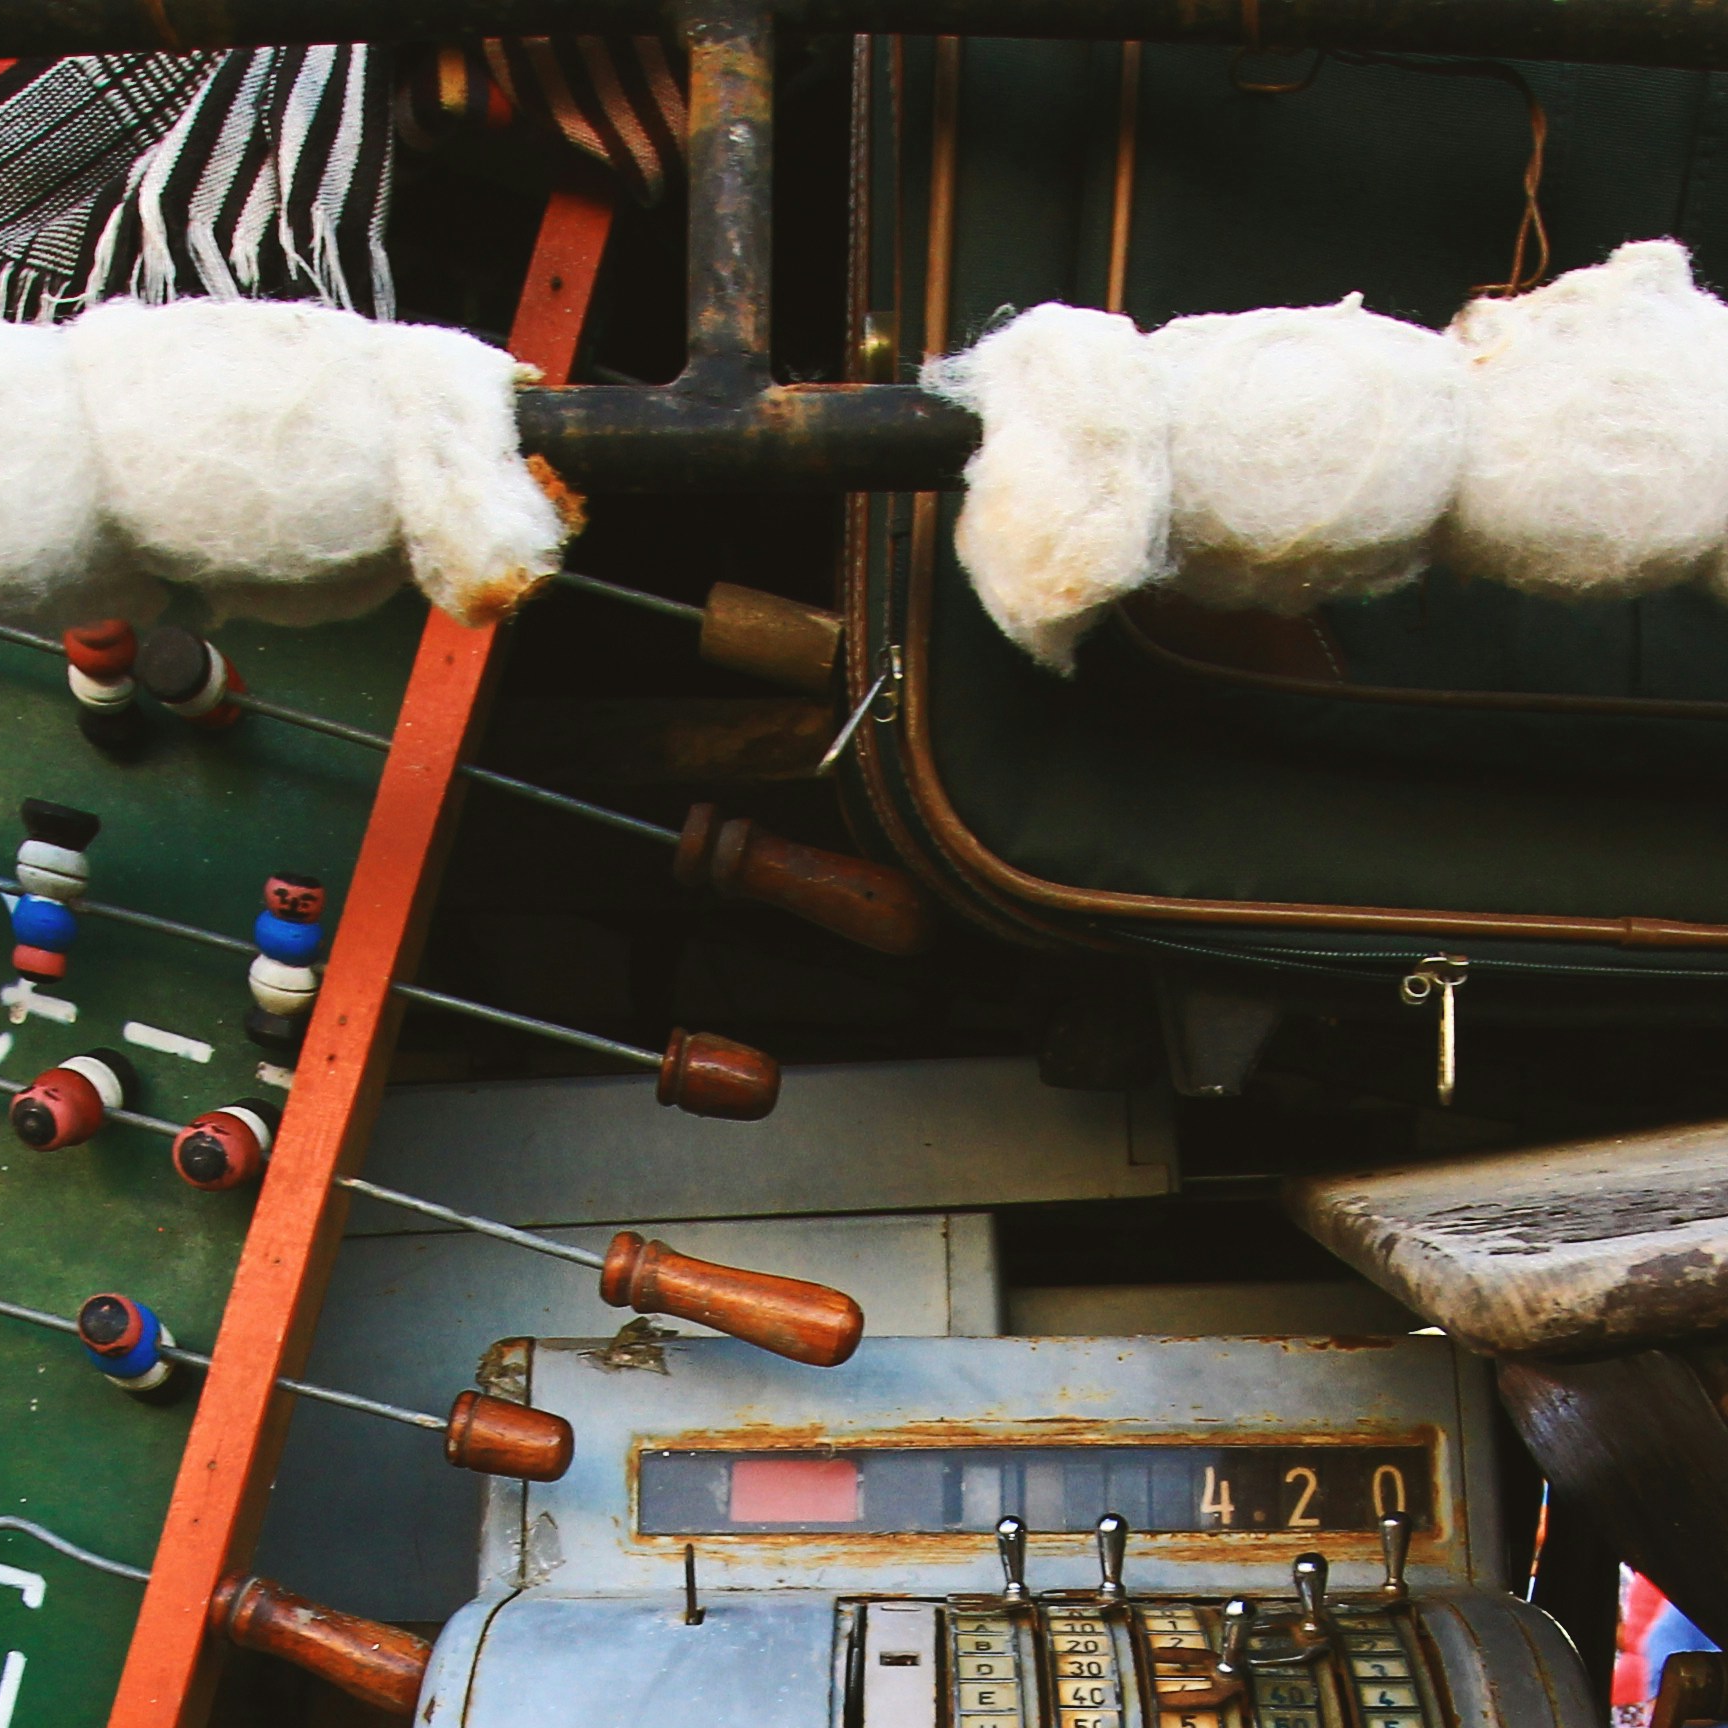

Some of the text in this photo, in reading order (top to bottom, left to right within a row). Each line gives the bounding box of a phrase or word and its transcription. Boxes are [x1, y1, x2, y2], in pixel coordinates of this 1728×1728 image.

[1064, 1623, 1095, 1634] 10
[1167, 1620, 1178, 1630] 1
[975, 1640, 993, 1652] B
[1066, 1640, 1099, 1653] 20
[976, 1663, 993, 1676] D
[1070, 1661, 1102, 1676] 30
[979, 1691, 995, 1705] E
[1072, 1687, 1106, 1705] 40
[1270, 1686, 1304, 1704] 40
[1378, 1690, 1395, 1706] 4
